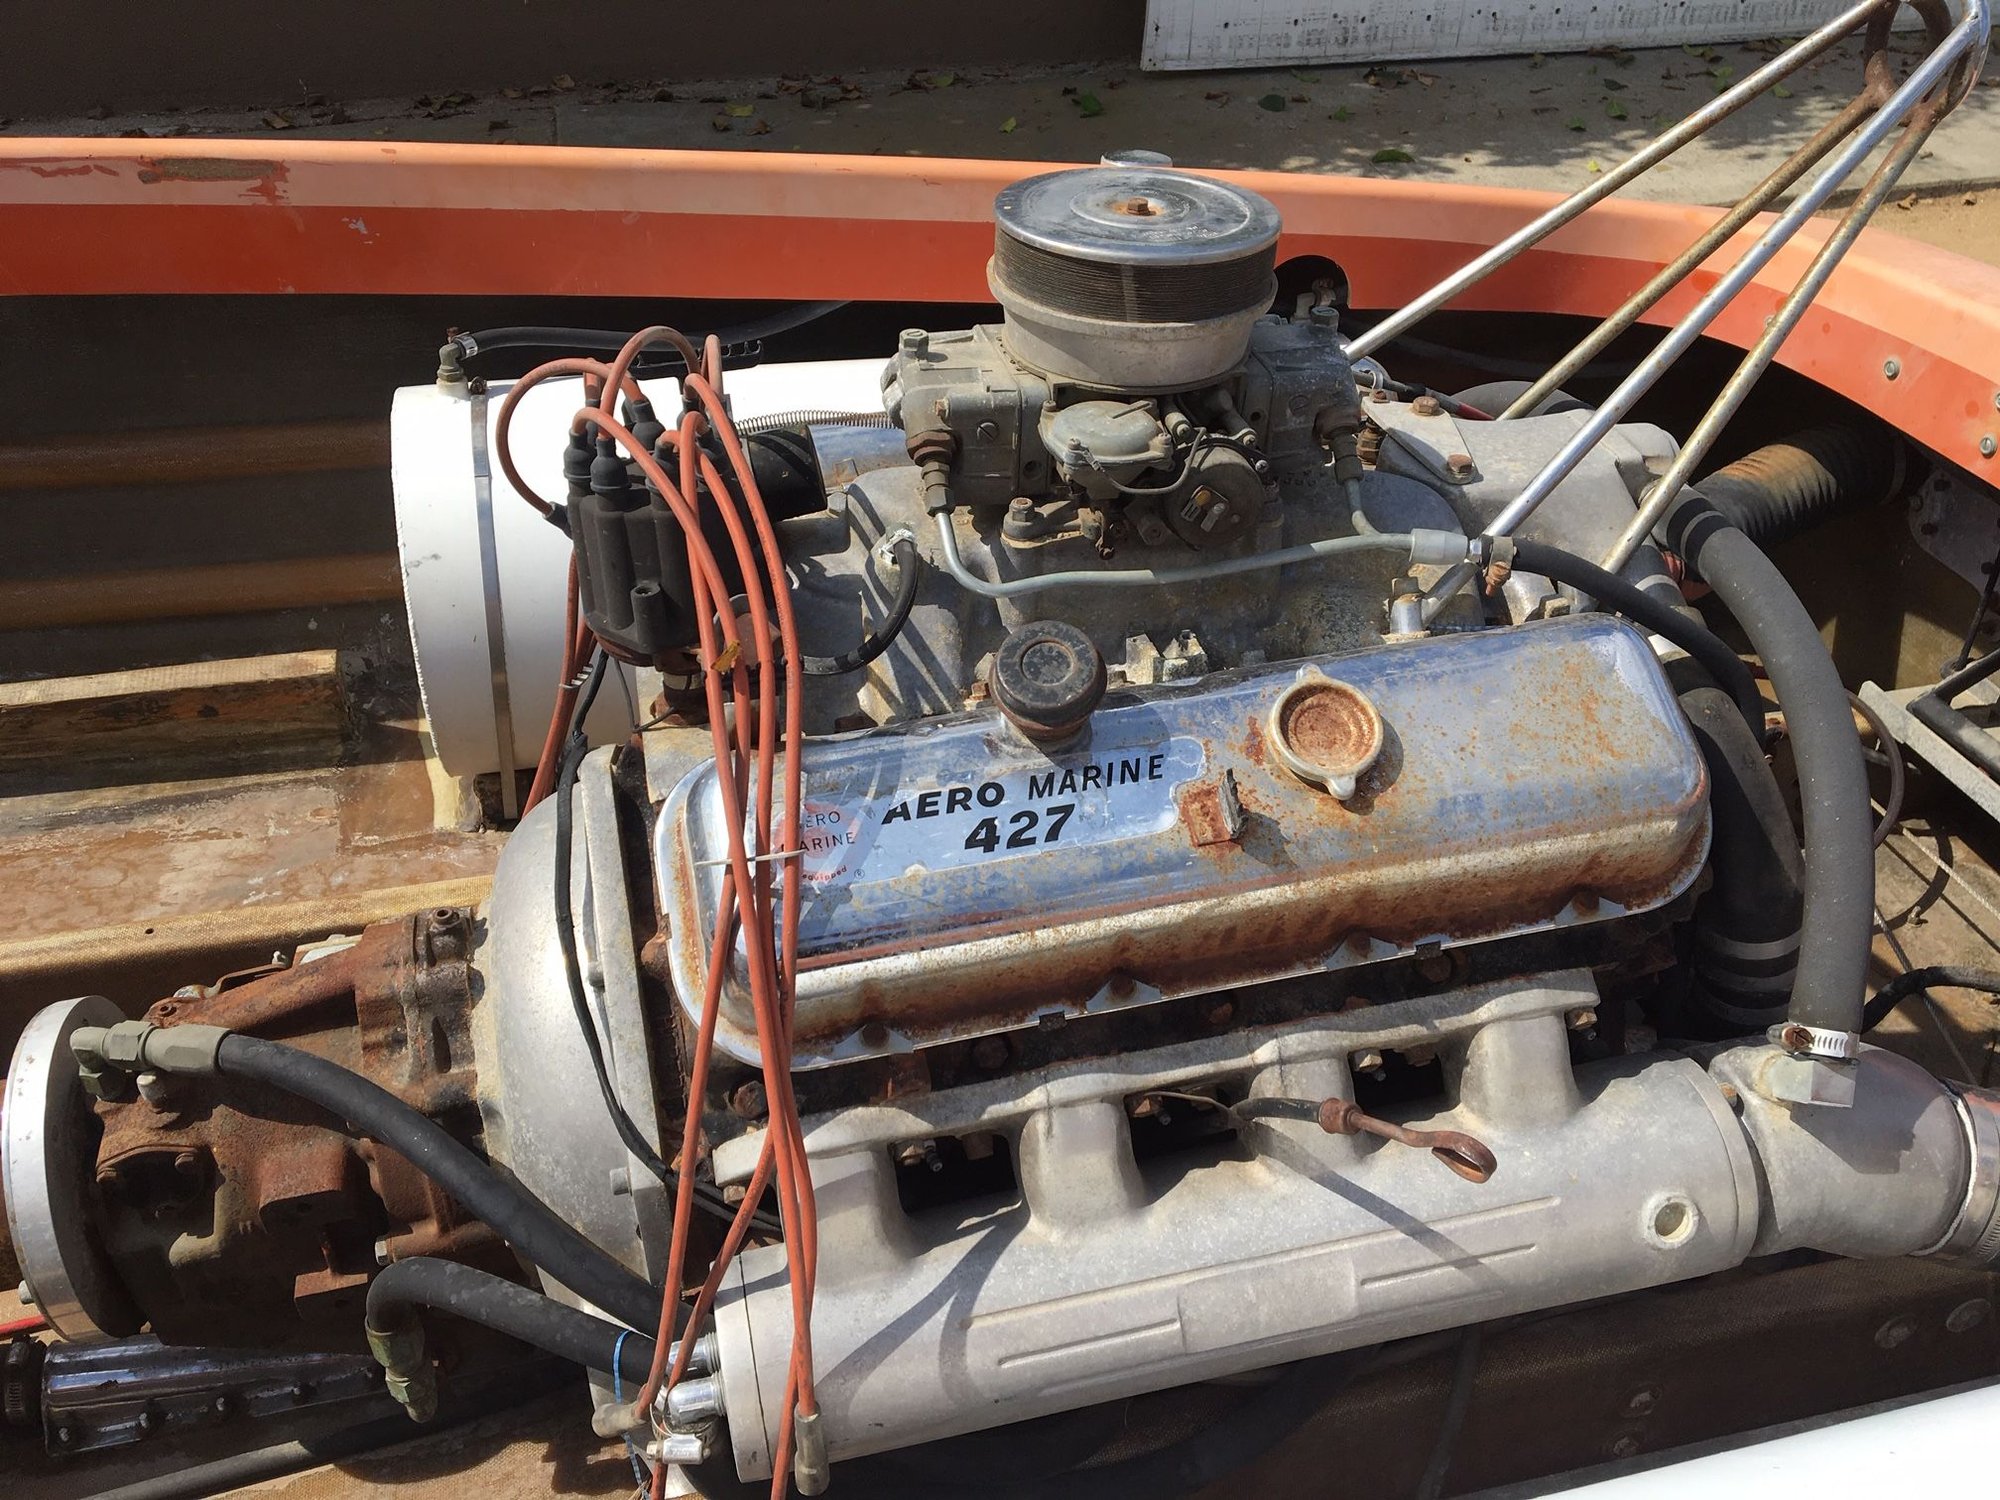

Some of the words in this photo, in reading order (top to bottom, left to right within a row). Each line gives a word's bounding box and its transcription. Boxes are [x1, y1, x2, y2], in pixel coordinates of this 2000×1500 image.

[881, 781, 1005, 825] AERO
[1028, 753, 1164, 800] MARINE
[799, 810, 841, 829] ERO
[964, 803, 1075, 854] 427
[781, 831, 855, 852] ARINE
